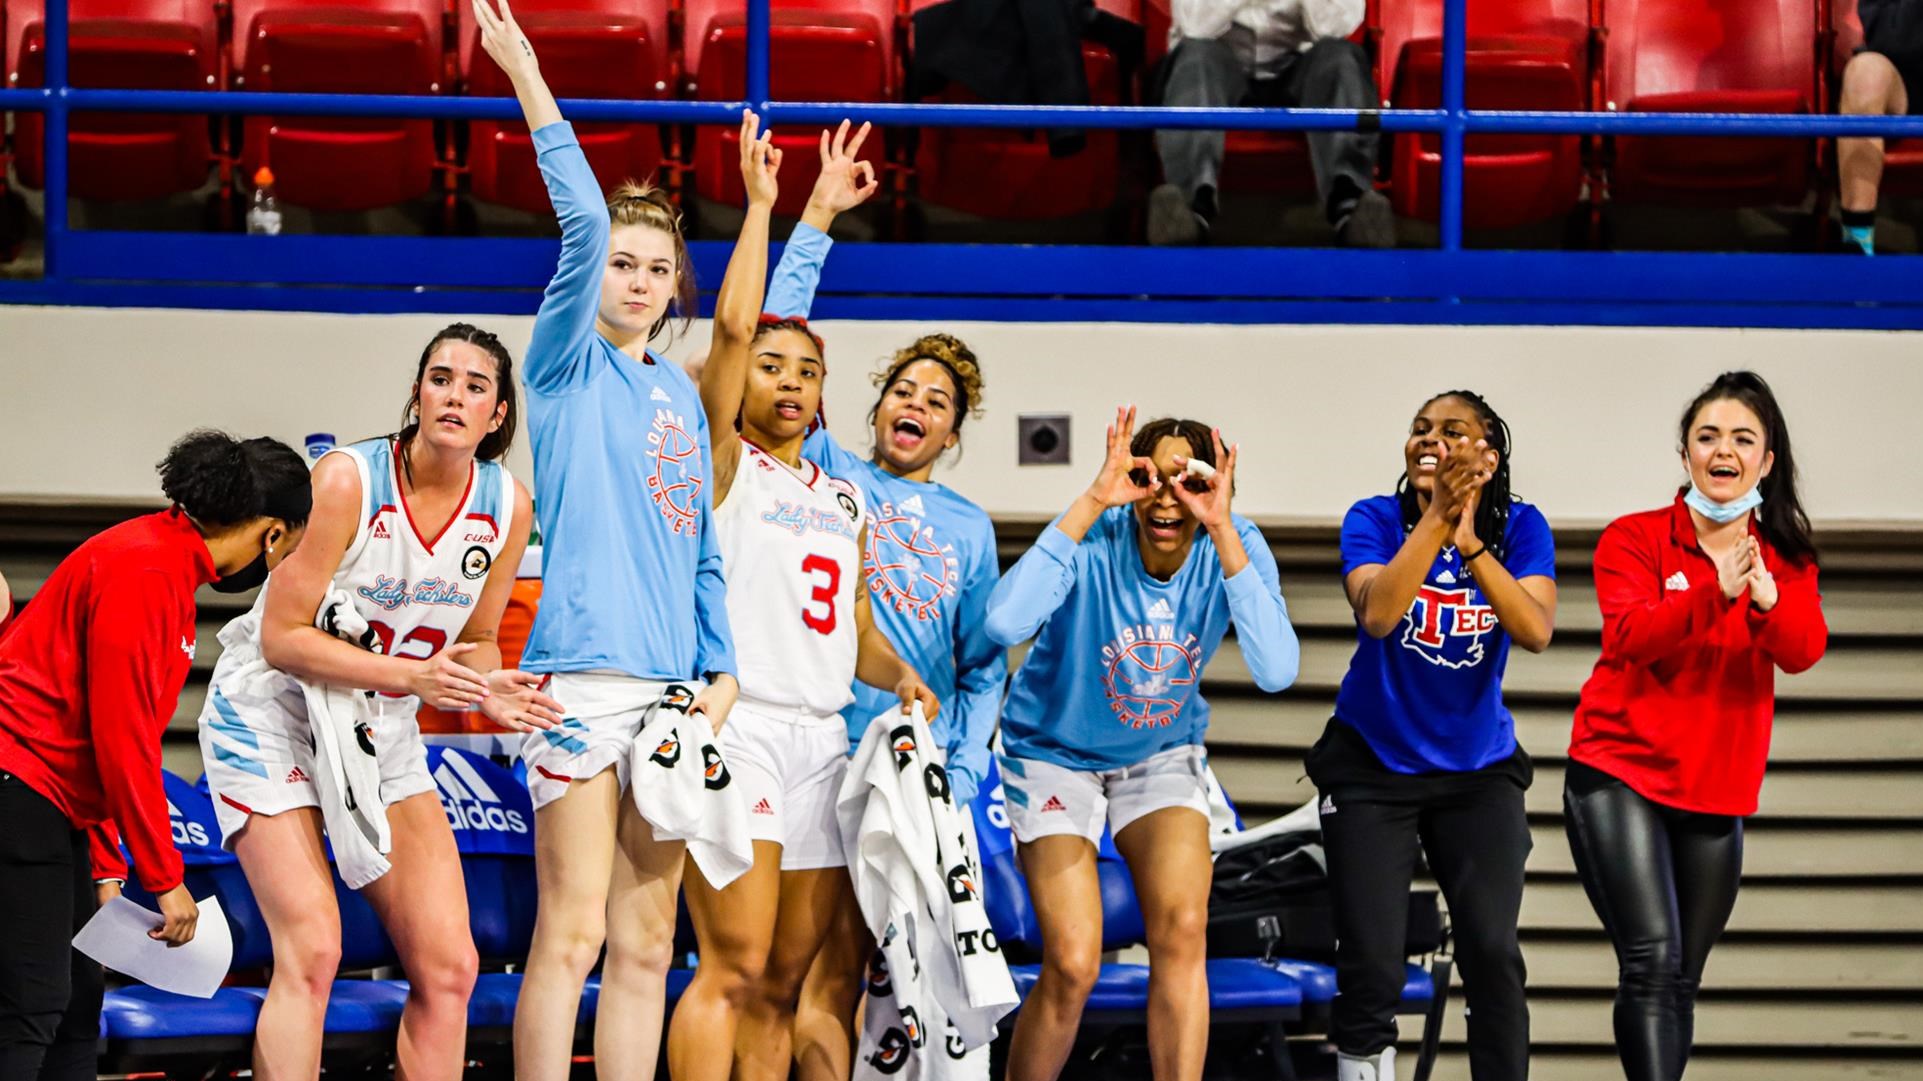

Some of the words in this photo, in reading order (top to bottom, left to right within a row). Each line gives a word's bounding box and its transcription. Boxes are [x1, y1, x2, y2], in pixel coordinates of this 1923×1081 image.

[761, 499, 807, 537] Lady
[357, 574, 408, 611] Lady
[801, 552, 841, 636] 3
[1412, 584, 1499, 649] TEC
[443, 797, 529, 834] didas
